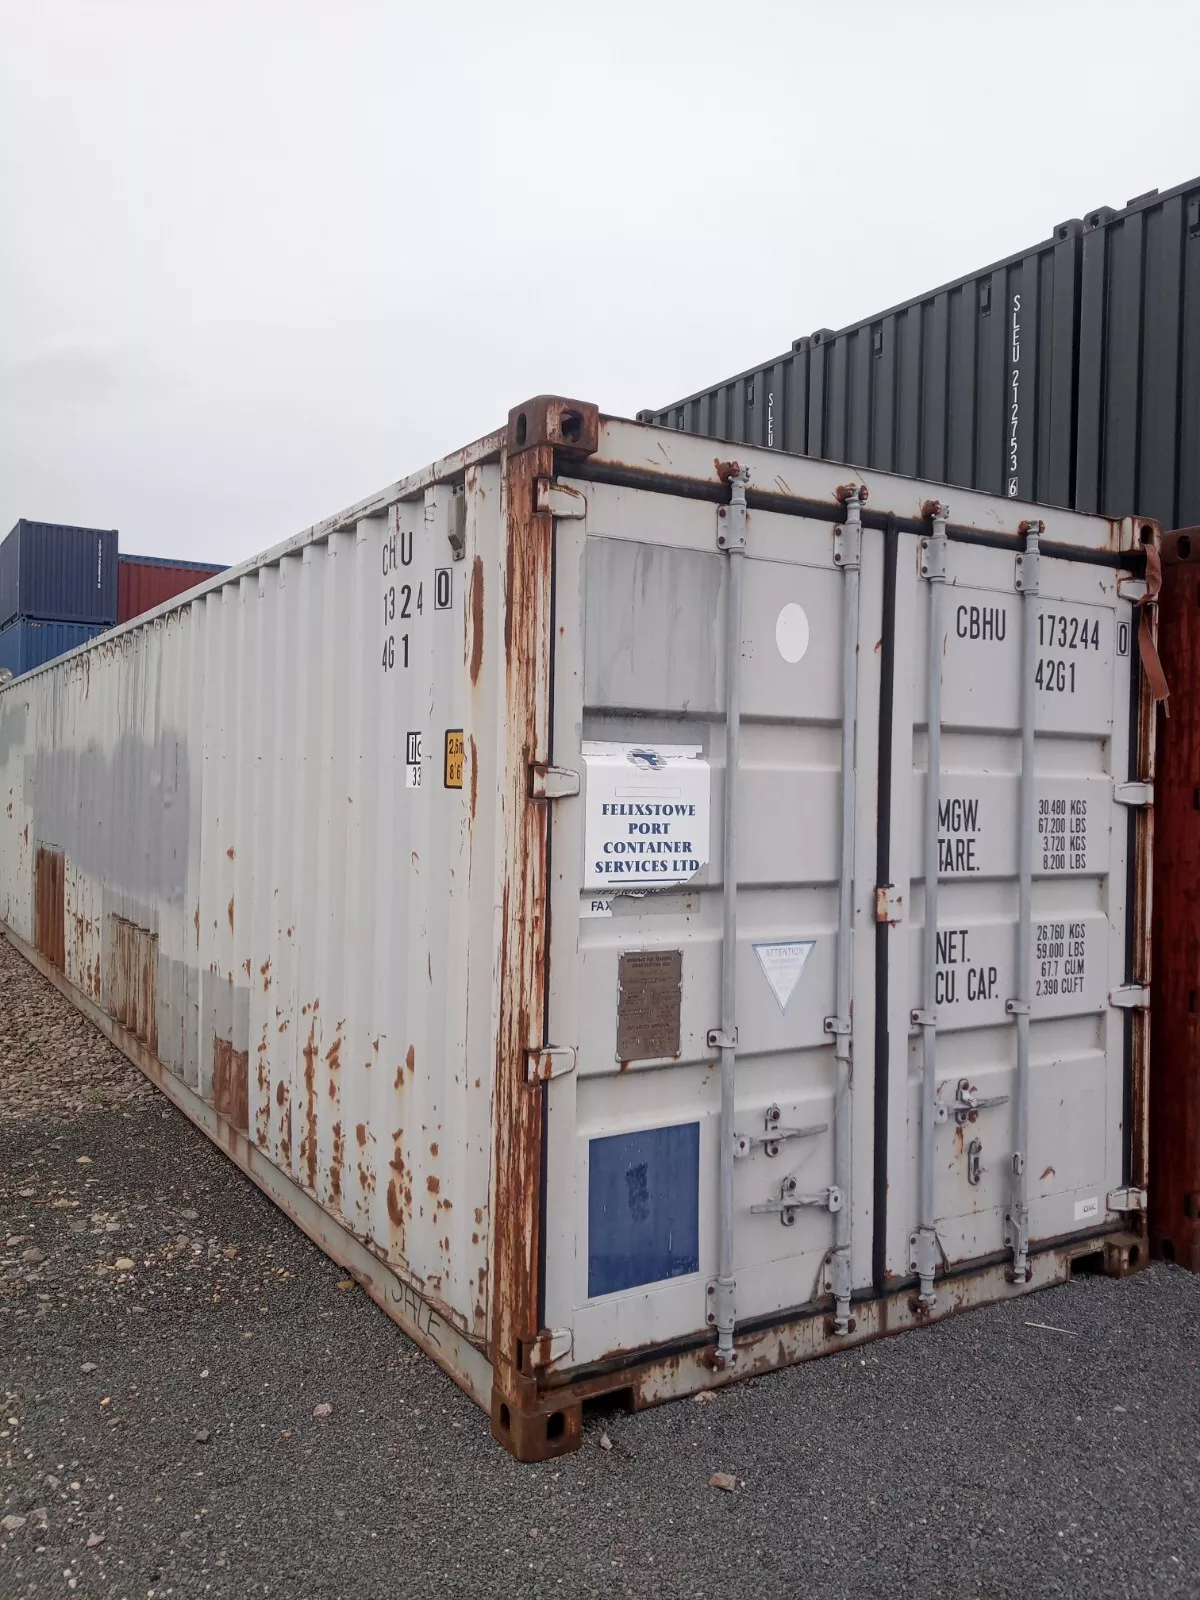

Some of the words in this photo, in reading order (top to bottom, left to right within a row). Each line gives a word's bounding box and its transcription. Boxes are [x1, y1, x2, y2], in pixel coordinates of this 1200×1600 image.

[1013, 294, 1021, 363] SLEU
[1010, 369, 1019, 472] 212753
[1009, 478, 1018, 496] 6
[437, 570, 450, 608] 0
[956, 605, 1006, 641] CBHU
[1037, 613, 1100, 651] 173244
[1118, 623, 1128, 655] 0
[1034, 658, 1076, 693] 42G1
[601, 803, 696, 817] FELIXSTOWE
[937, 798, 981, 832] MGW.
[1038, 800, 1066, 816] 30.480
[1070, 799, 1087, 815] KGS
[628, 822, 671, 835] PORT
[1038, 818, 1066, 833] 67.200
[1070, 817, 1086, 833] LBS
[603, 841, 693, 854] CONTAINER
[1043, 836, 1066, 851] 3.720
[1069, 835, 1086, 851] KGS
[937, 838, 980, 872] TARE.
[1043, 854, 1066, 870] 8.200
[1069, 853, 1086, 869] LBS
[595, 860, 668, 874] SERVICES
[672, 859, 700, 872] LTD
[591, 900, 612, 912] FAX
[1037, 924, 1065, 941] 26.760
[1069, 923, 1086, 939] KGS
[765, 946, 804, 957] ATTENTION
[935, 929, 971, 965] NET.
[1036, 942, 1064, 959] 59.000
[1068, 941, 1085, 958] LBS
[1041, 961, 1059, 977] 67.7
[935, 969, 959, 1005] CU.
[967, 966, 998, 1001] CAP.
[1036, 979, 1058, 996] 2.390
[1061, 977, 1084, 994] CU.FT
